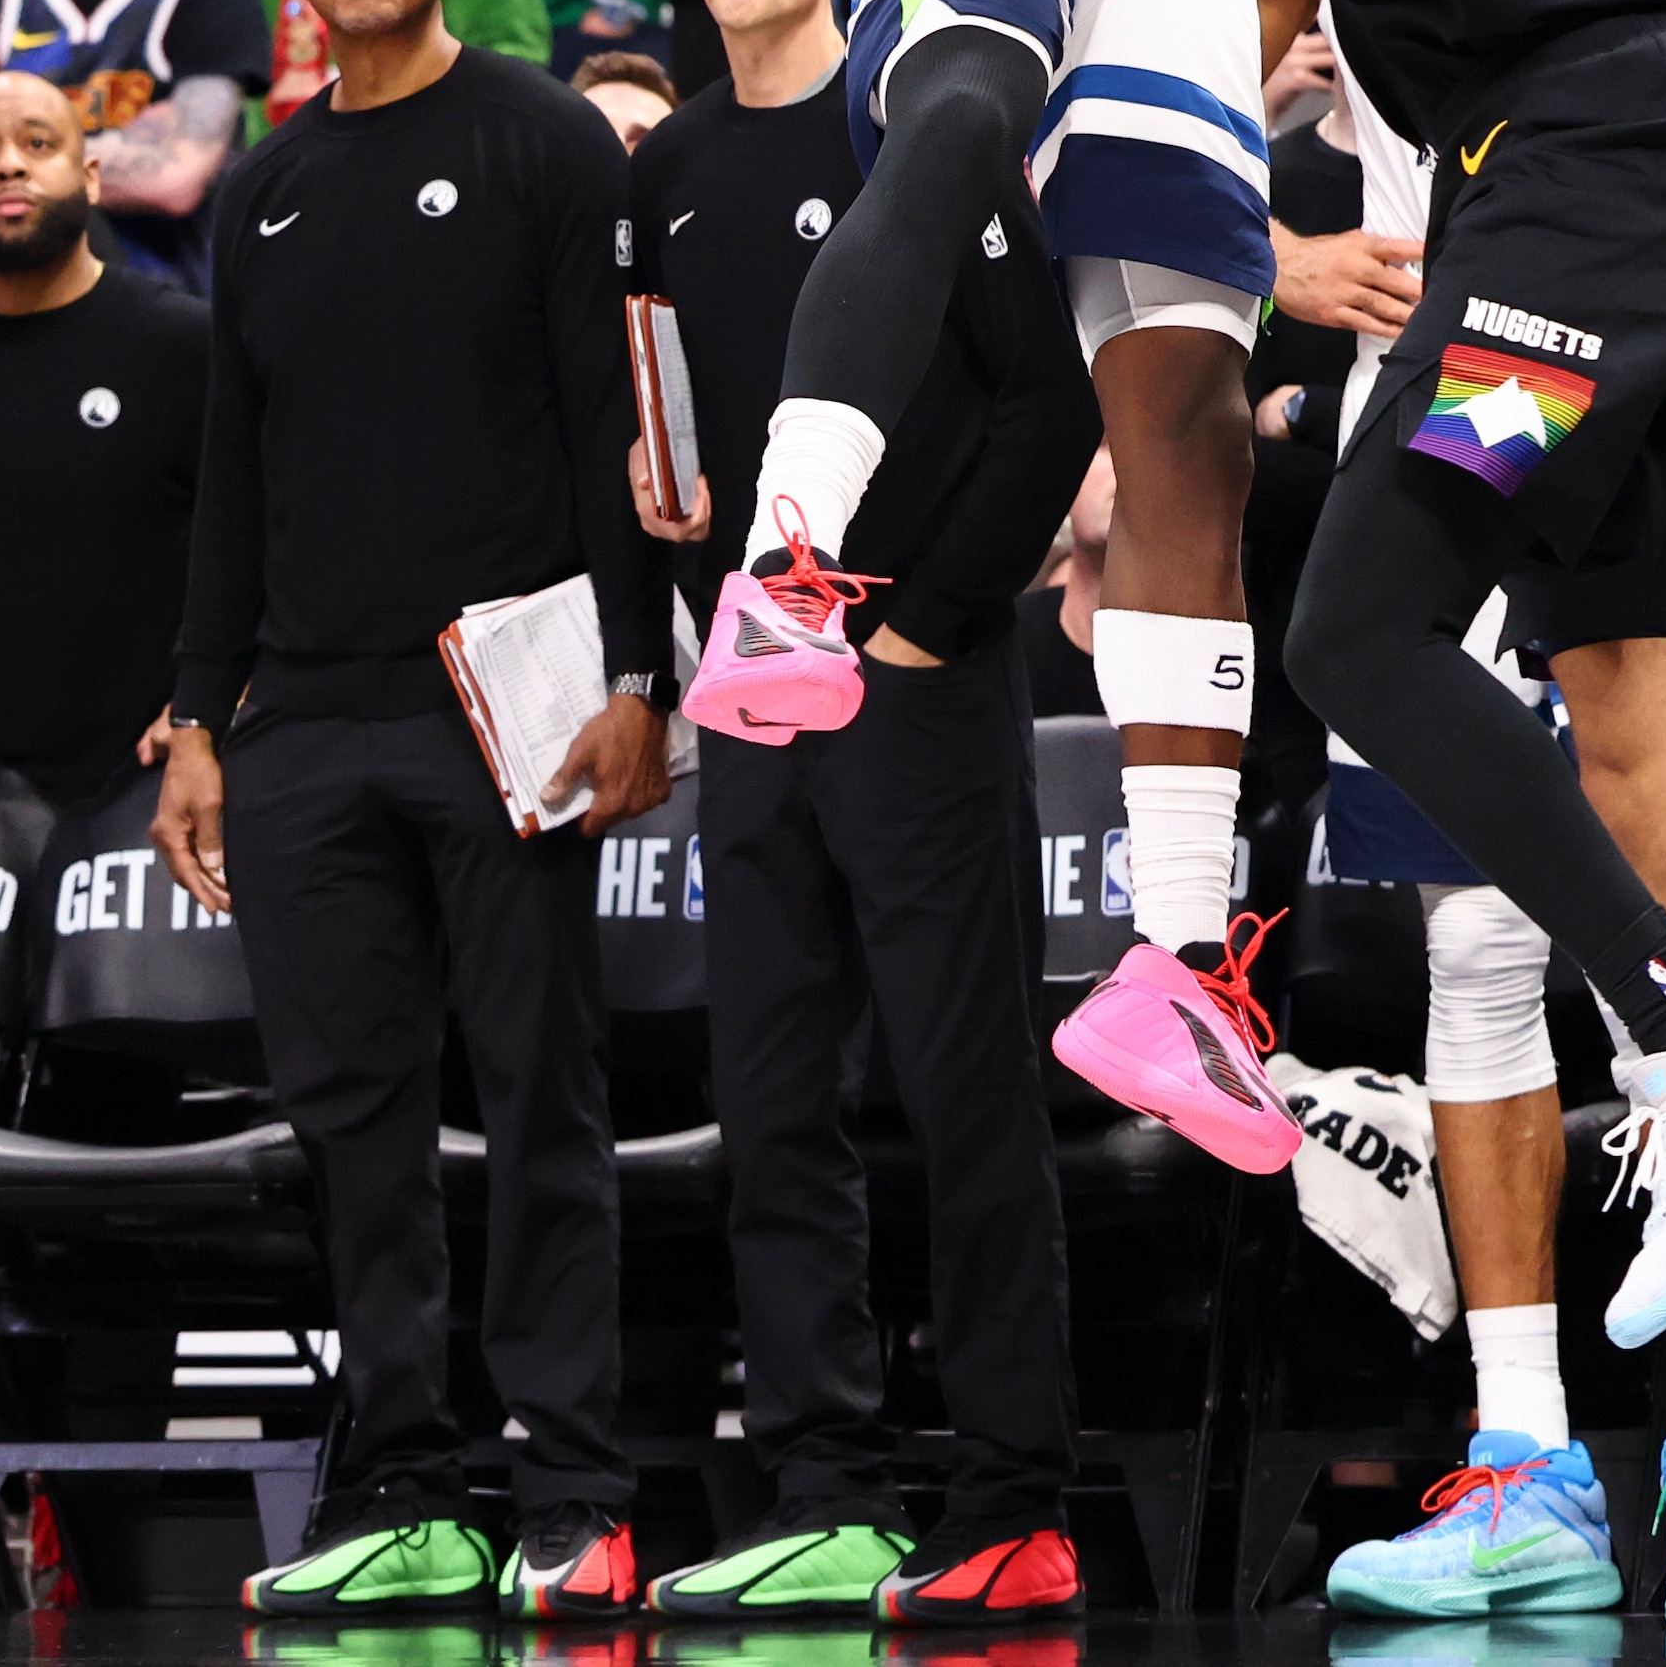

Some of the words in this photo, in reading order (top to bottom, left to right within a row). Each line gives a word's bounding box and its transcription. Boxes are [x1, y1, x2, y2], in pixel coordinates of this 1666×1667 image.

[1462, 296, 1604, 362] NUGGETS
[1209, 655, 1245, 690] 5
[55, 848, 155, 936] GET
[596, 837, 671, 918] HE
